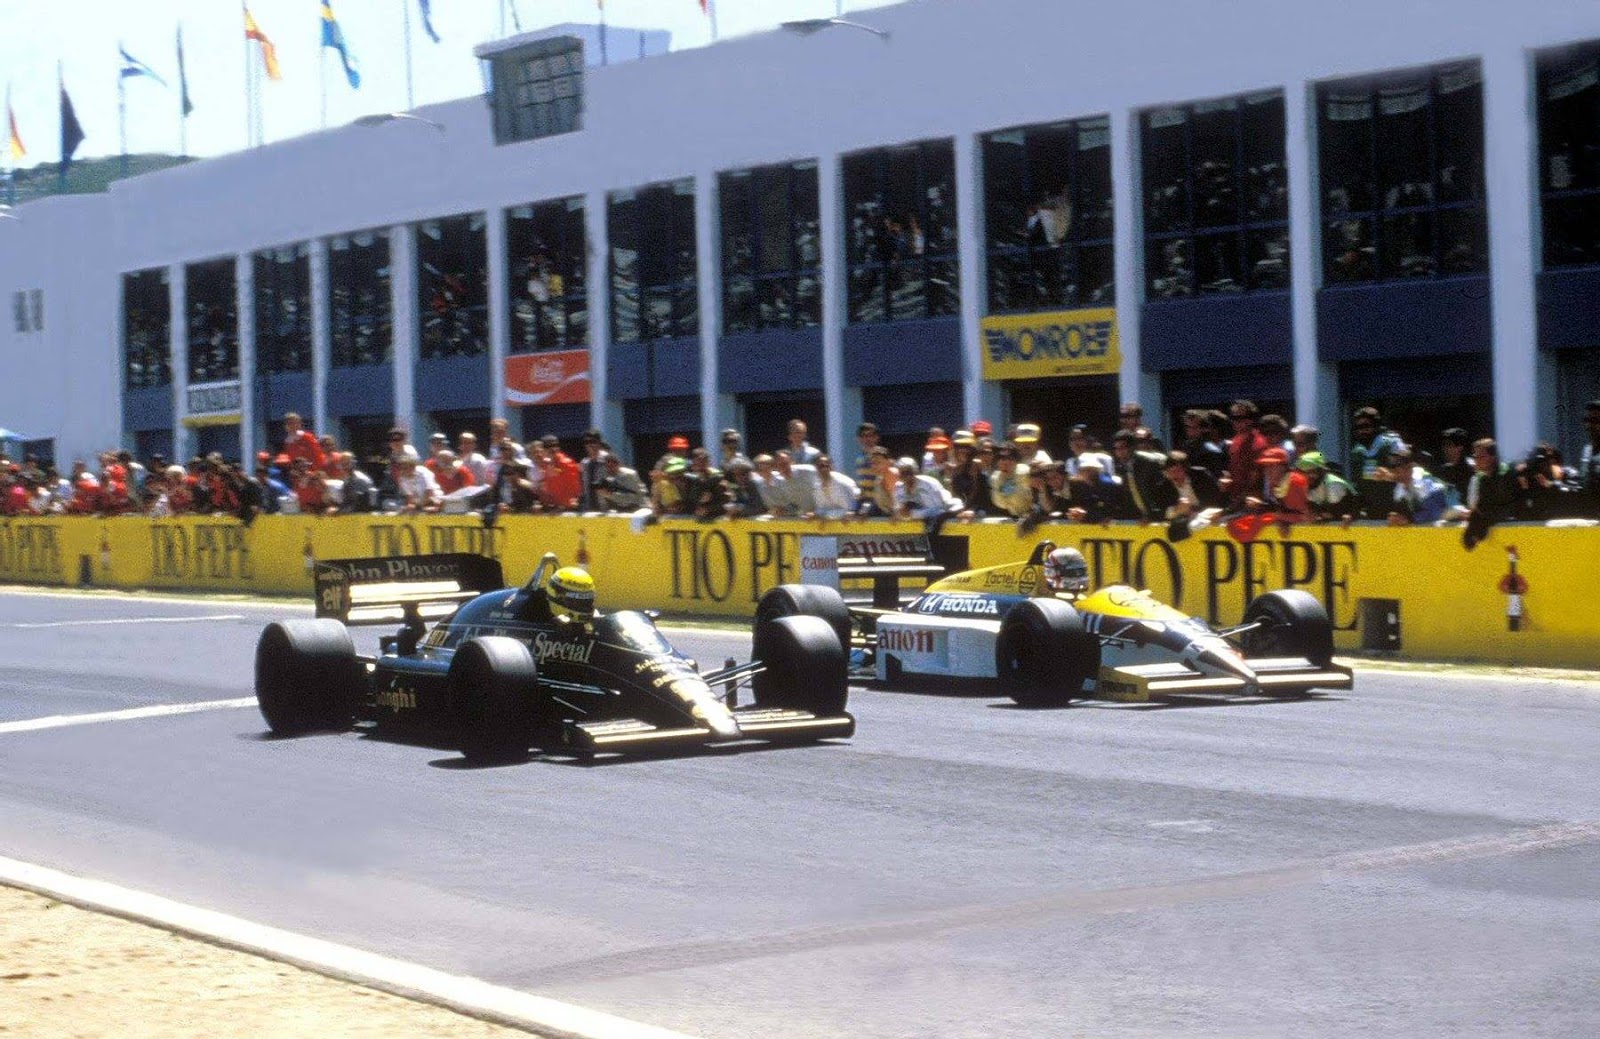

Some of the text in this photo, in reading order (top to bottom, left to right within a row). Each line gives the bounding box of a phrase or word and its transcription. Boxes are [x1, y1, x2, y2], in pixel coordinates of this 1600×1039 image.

[838, 541, 916, 557] anon
[663, 527, 799, 603] TIO PE
[1080, 537, 1359, 632] TIO PEPE
[940, 597, 998, 614] HONDA
[535, 632, 596, 665] Special
[879, 628, 935, 653] anon
